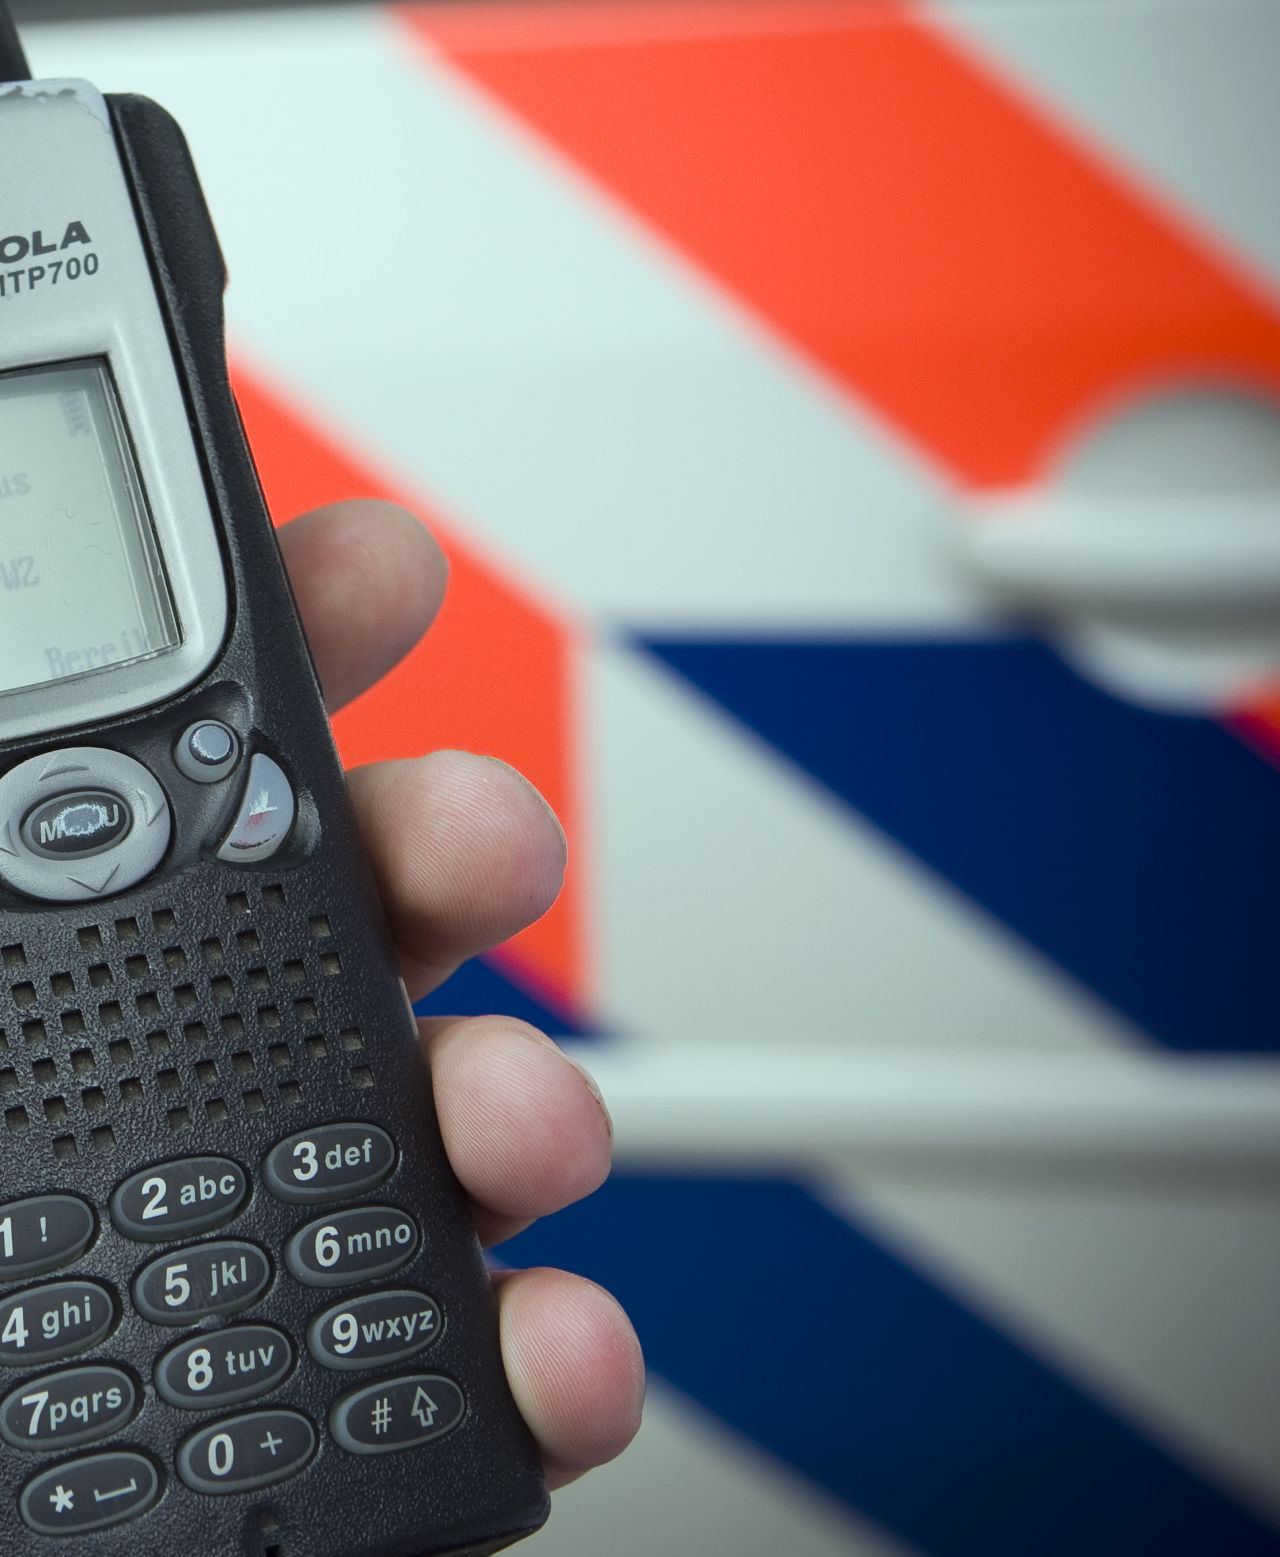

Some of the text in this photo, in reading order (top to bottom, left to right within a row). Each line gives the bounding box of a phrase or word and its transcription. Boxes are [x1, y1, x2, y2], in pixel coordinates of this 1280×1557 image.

[325, 1138, 373, 1170] def
[141, 1172, 236, 1219] 2 abc
[347, 1223, 411, 1256] mno
[164, 1256, 248, 1307] 5 jkl
[1, 1296, 91, 1349] 4 ghi
[186, 1345, 274, 1391] 8 tuv
[207, 1433, 235, 1477] 0
